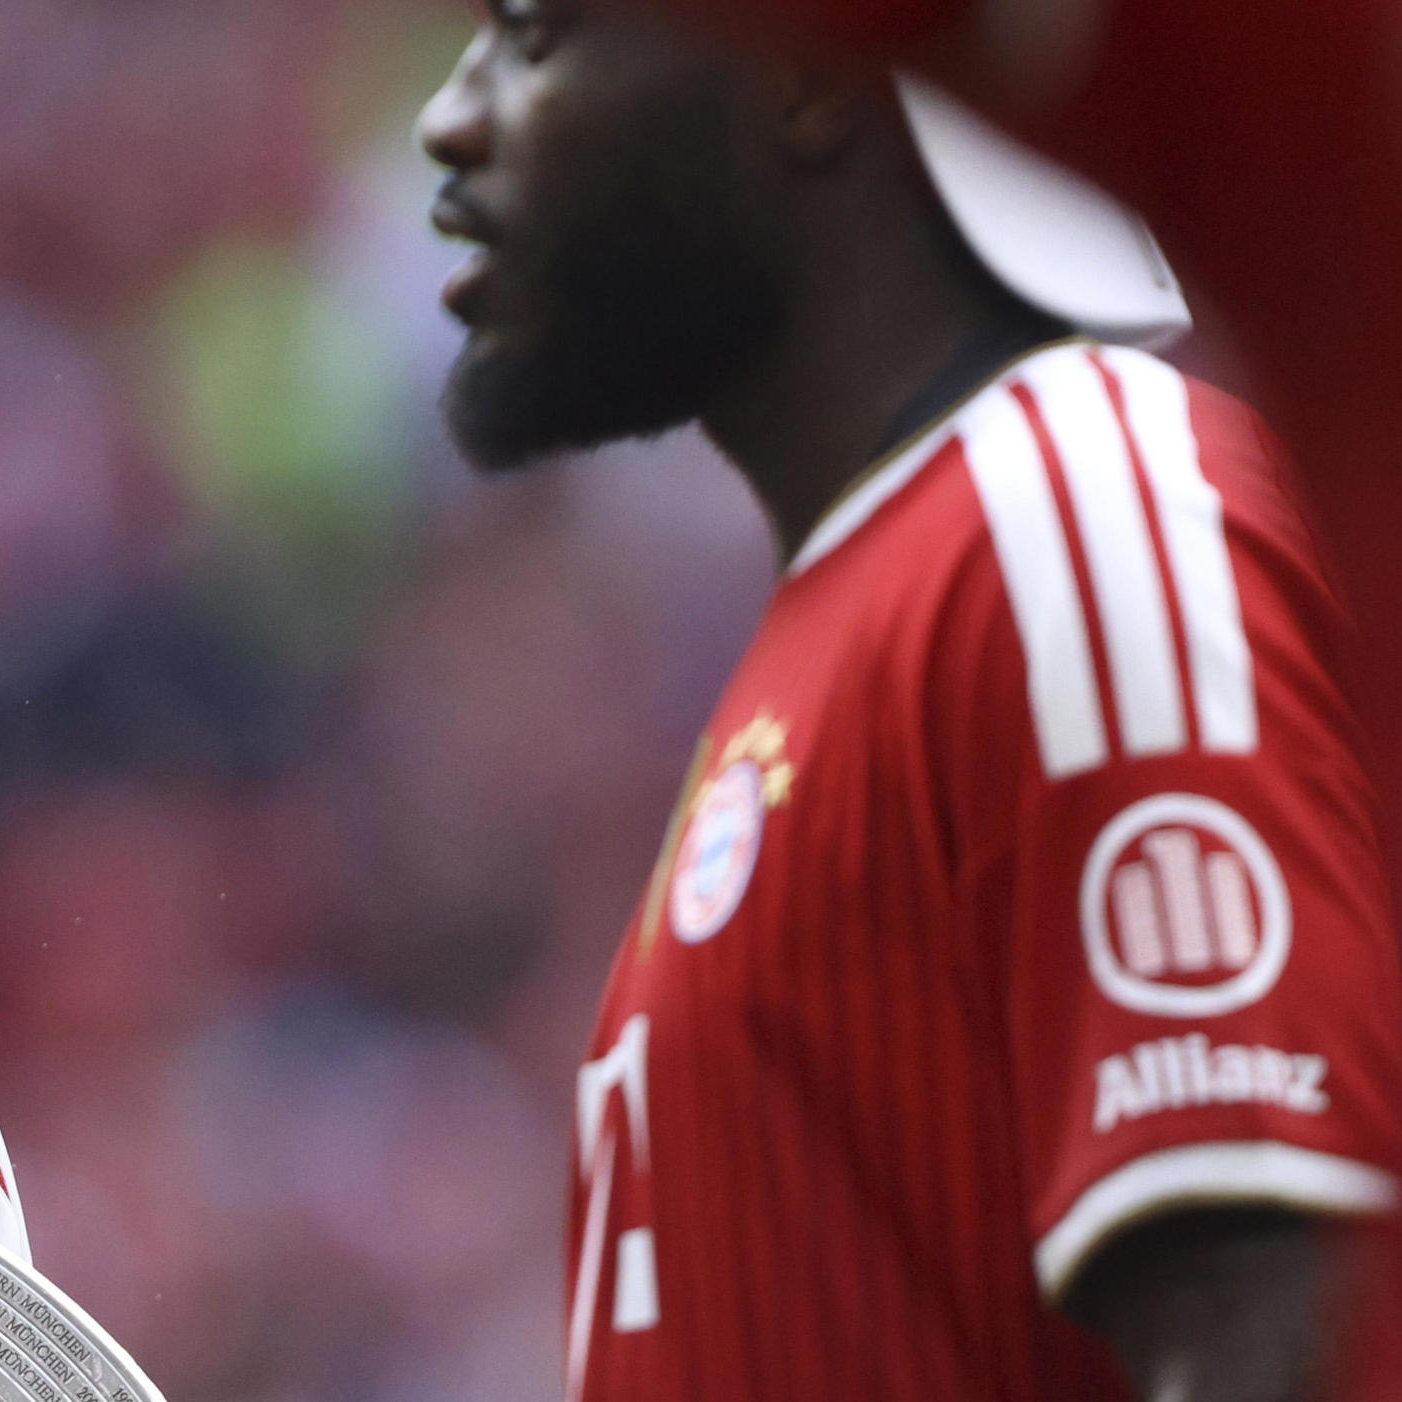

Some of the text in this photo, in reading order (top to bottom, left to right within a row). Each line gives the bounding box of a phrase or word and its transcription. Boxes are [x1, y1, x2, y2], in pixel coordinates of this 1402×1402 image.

[1093, 1031, 1330, 1133] Allianz
[4, 1316, 74, 1383] MÜNCHEN
[18, 1294, 90, 1362] MÜNCHEN
